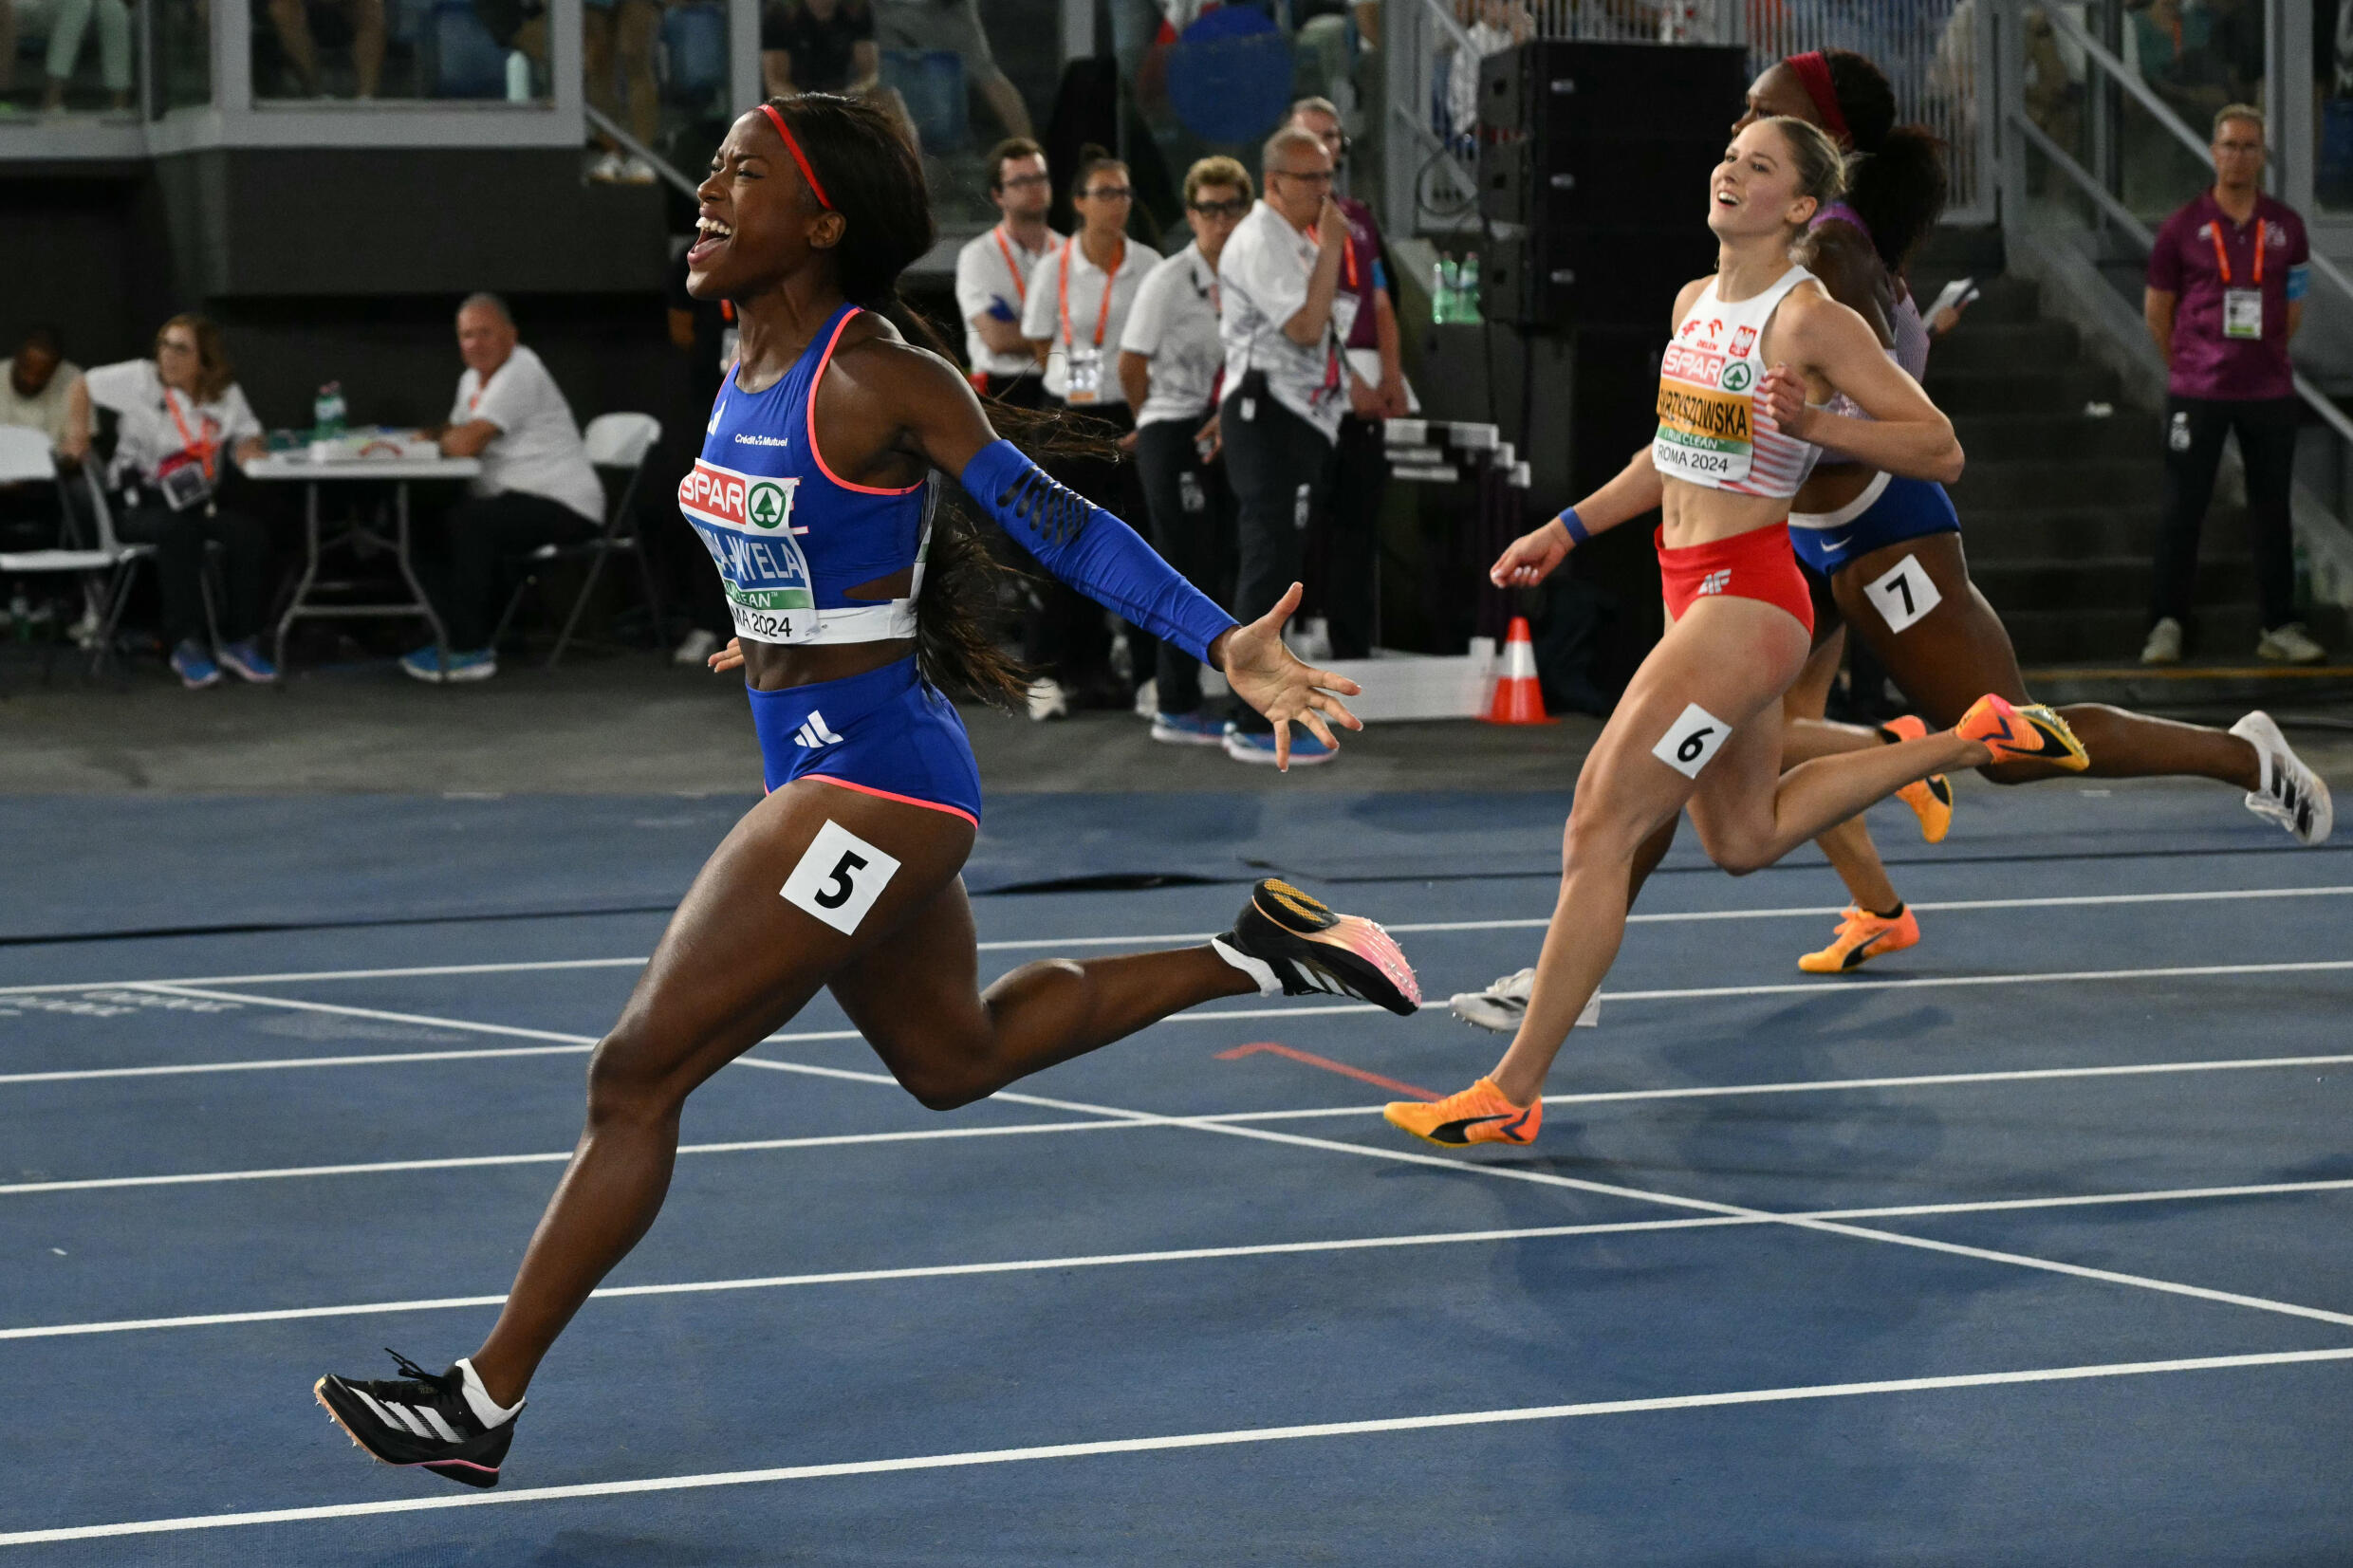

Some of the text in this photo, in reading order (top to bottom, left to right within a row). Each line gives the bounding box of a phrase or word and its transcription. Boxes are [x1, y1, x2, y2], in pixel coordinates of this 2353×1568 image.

[1696, 340, 1718, 351] ORLEN
[1662, 347, 1724, 383] SPAR
[763, 436, 788, 447] Mutuel
[1658, 444, 1729, 472] ROMA 2024
[680, 470, 744, 518] SPAR
[1884, 572, 1916, 617] 7
[751, 612, 793, 637] 2024
[1677, 727, 1715, 763] 6
[813, 849, 869, 910] 5
